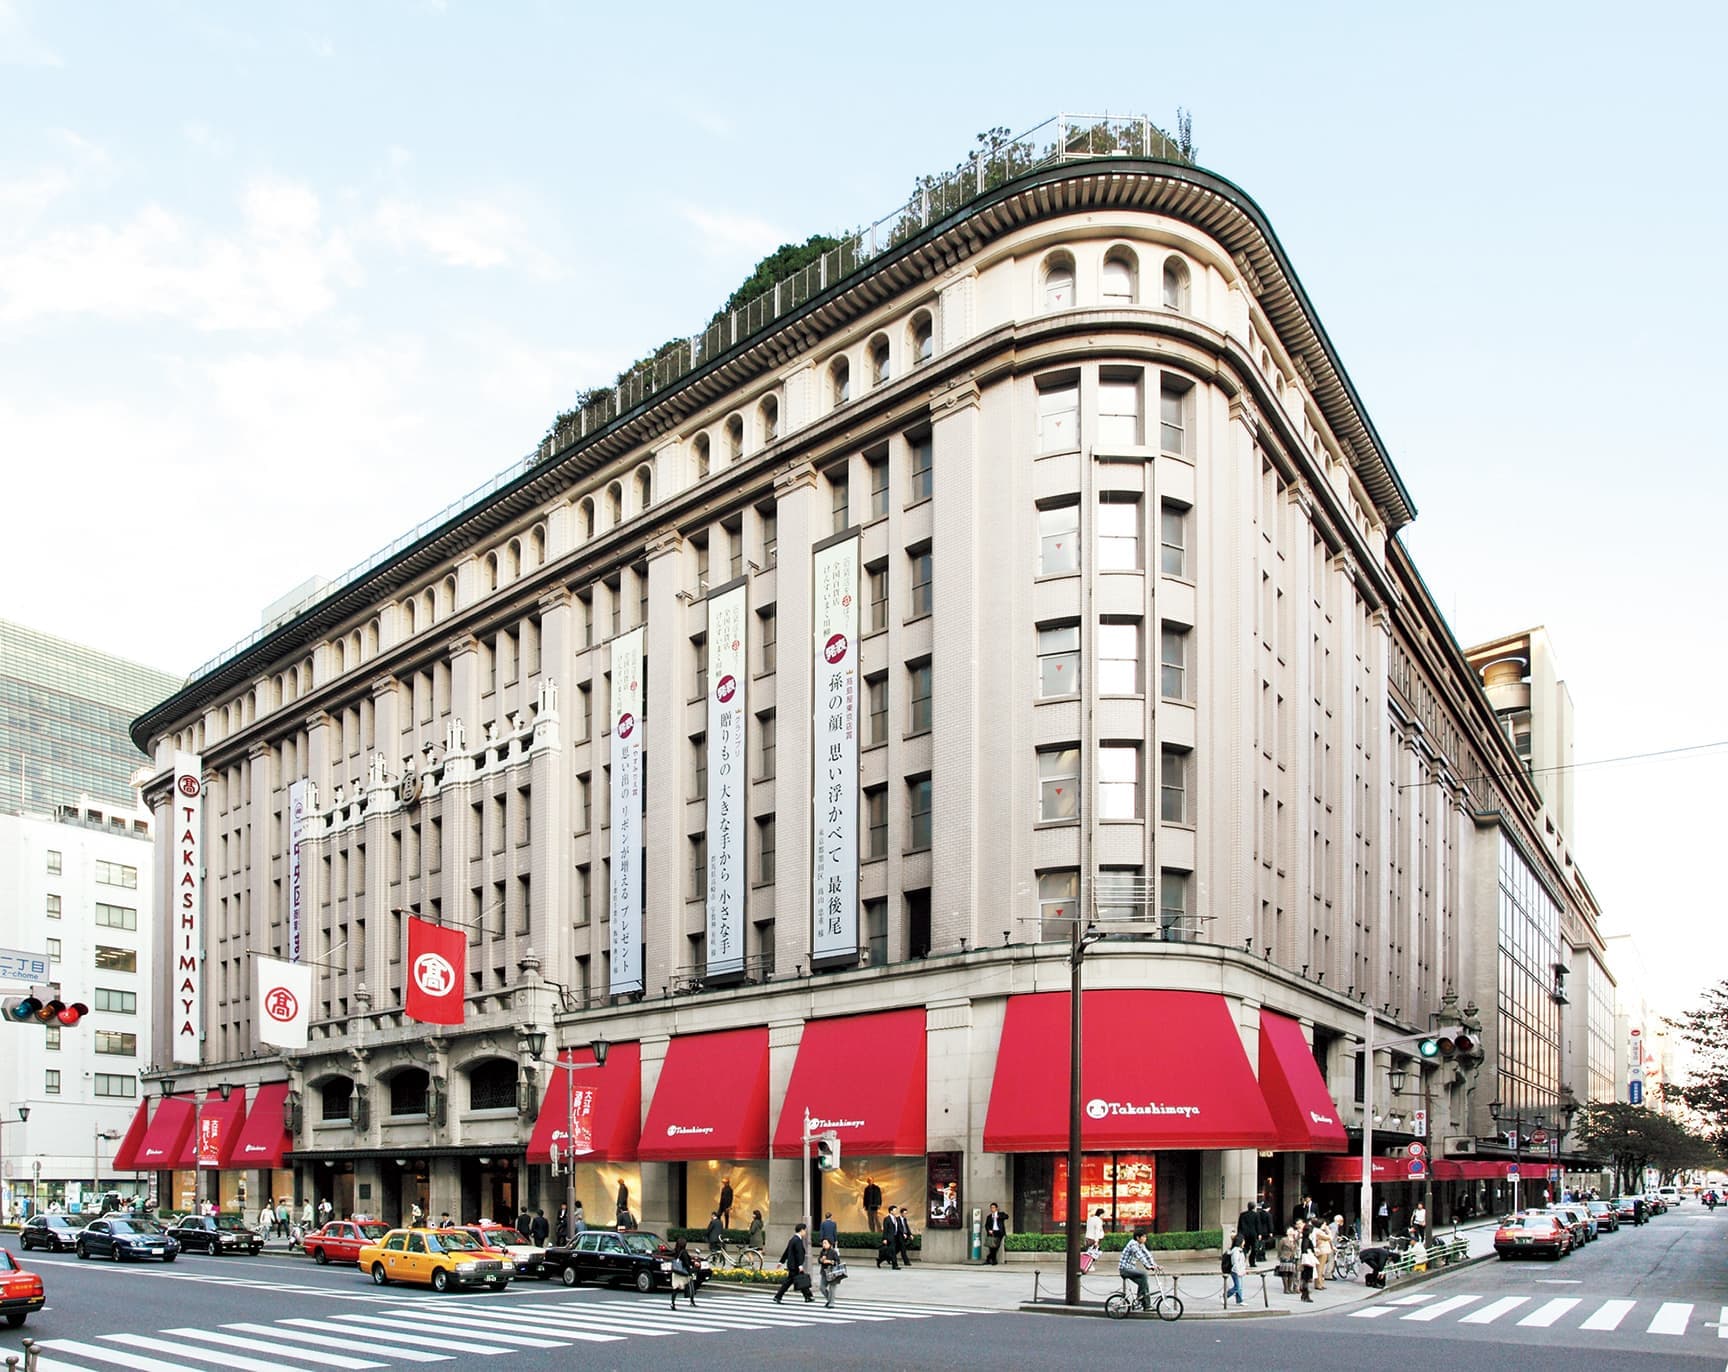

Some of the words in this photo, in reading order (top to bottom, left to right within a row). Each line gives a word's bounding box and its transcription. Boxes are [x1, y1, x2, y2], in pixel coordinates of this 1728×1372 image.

[828, 671, 843, 732] 孫の顔
[620, 745, 630, 800] 思い出の
[719, 711, 732, 777] 贈りもの
[719, 783, 731, 882] 大きな手から
[828, 742, 843, 863] 思い浮かべて
[620, 804, 630, 900] リボンが増える
[179, 806, 196, 1037] TAKASHIMAYA
[719, 888, 731, 955] 小さな手
[827, 875, 843, 936] 最後尾
[0, 956, 45, 974] 二丁目
[620, 904, 630, 974] プレゼント
[2, 969, 39, 980] 2-chome
[819, 1119, 865, 1129] Takashimaya
[1108, 1102, 1200, 1118] Takashimaya
